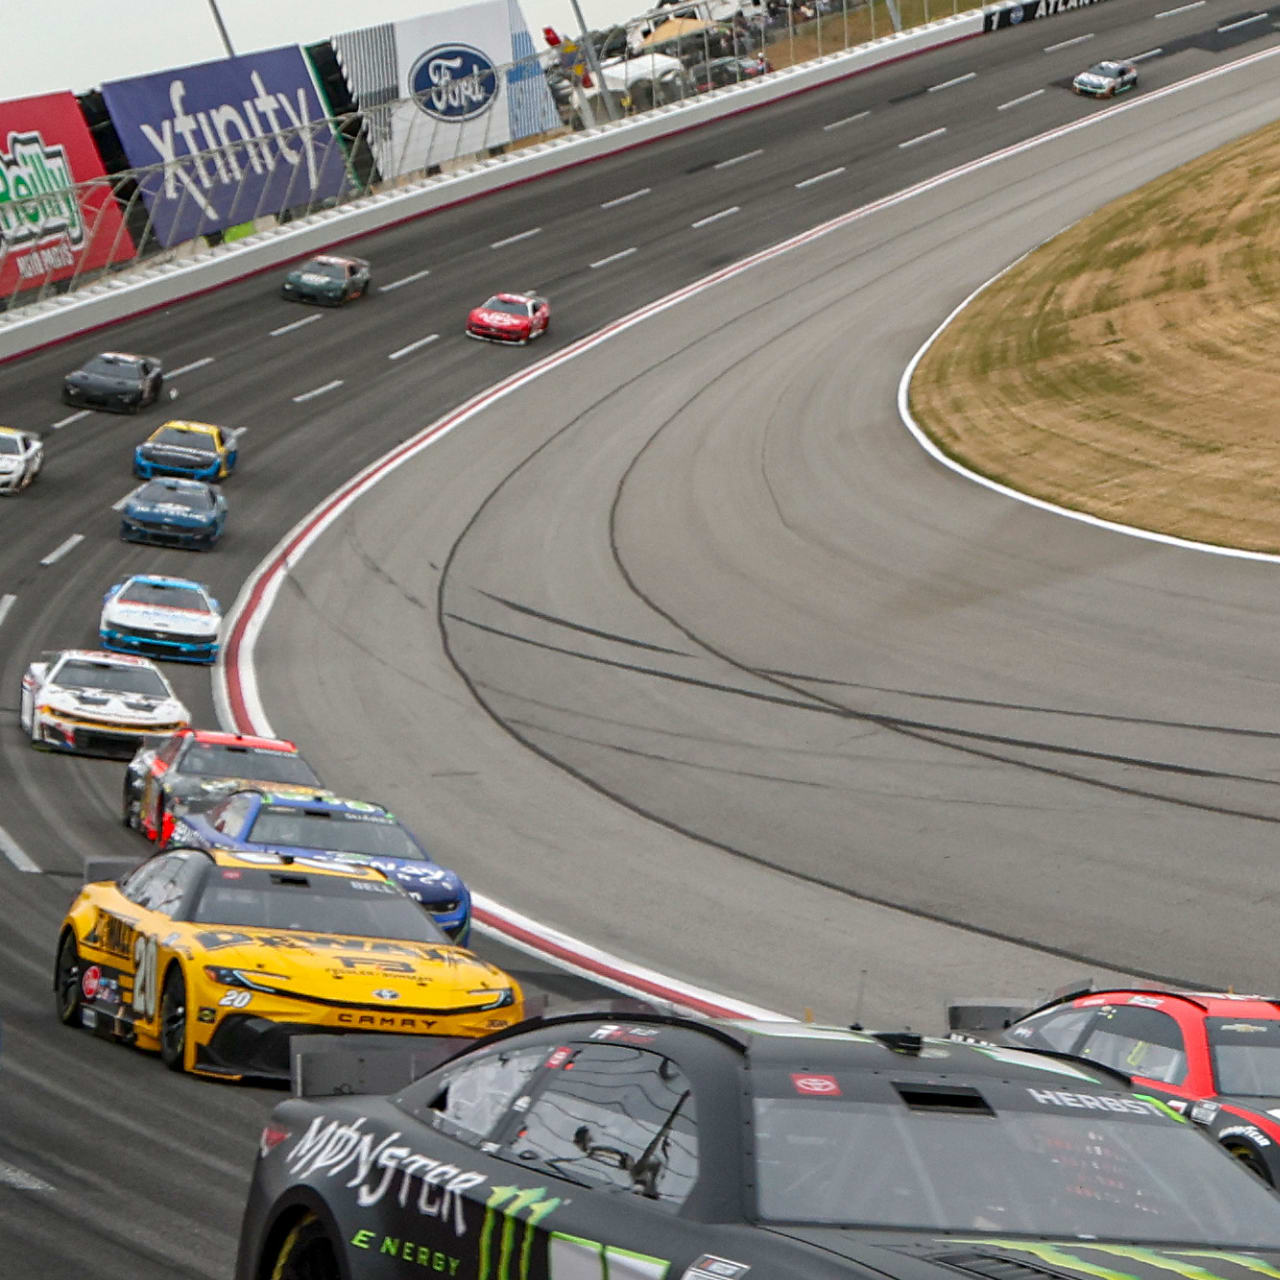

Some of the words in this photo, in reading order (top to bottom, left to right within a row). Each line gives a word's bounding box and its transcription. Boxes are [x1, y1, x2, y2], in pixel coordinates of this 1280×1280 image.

[428, 56, 487, 111] Ford
[140, 70, 318, 220] xfinity
[218, 989, 252, 1009] 20
[337, 1012, 438, 1029] CAMRY
[1026, 1087, 1166, 1118] HERBST
[350, 1229, 461, 1277] ENERGY
